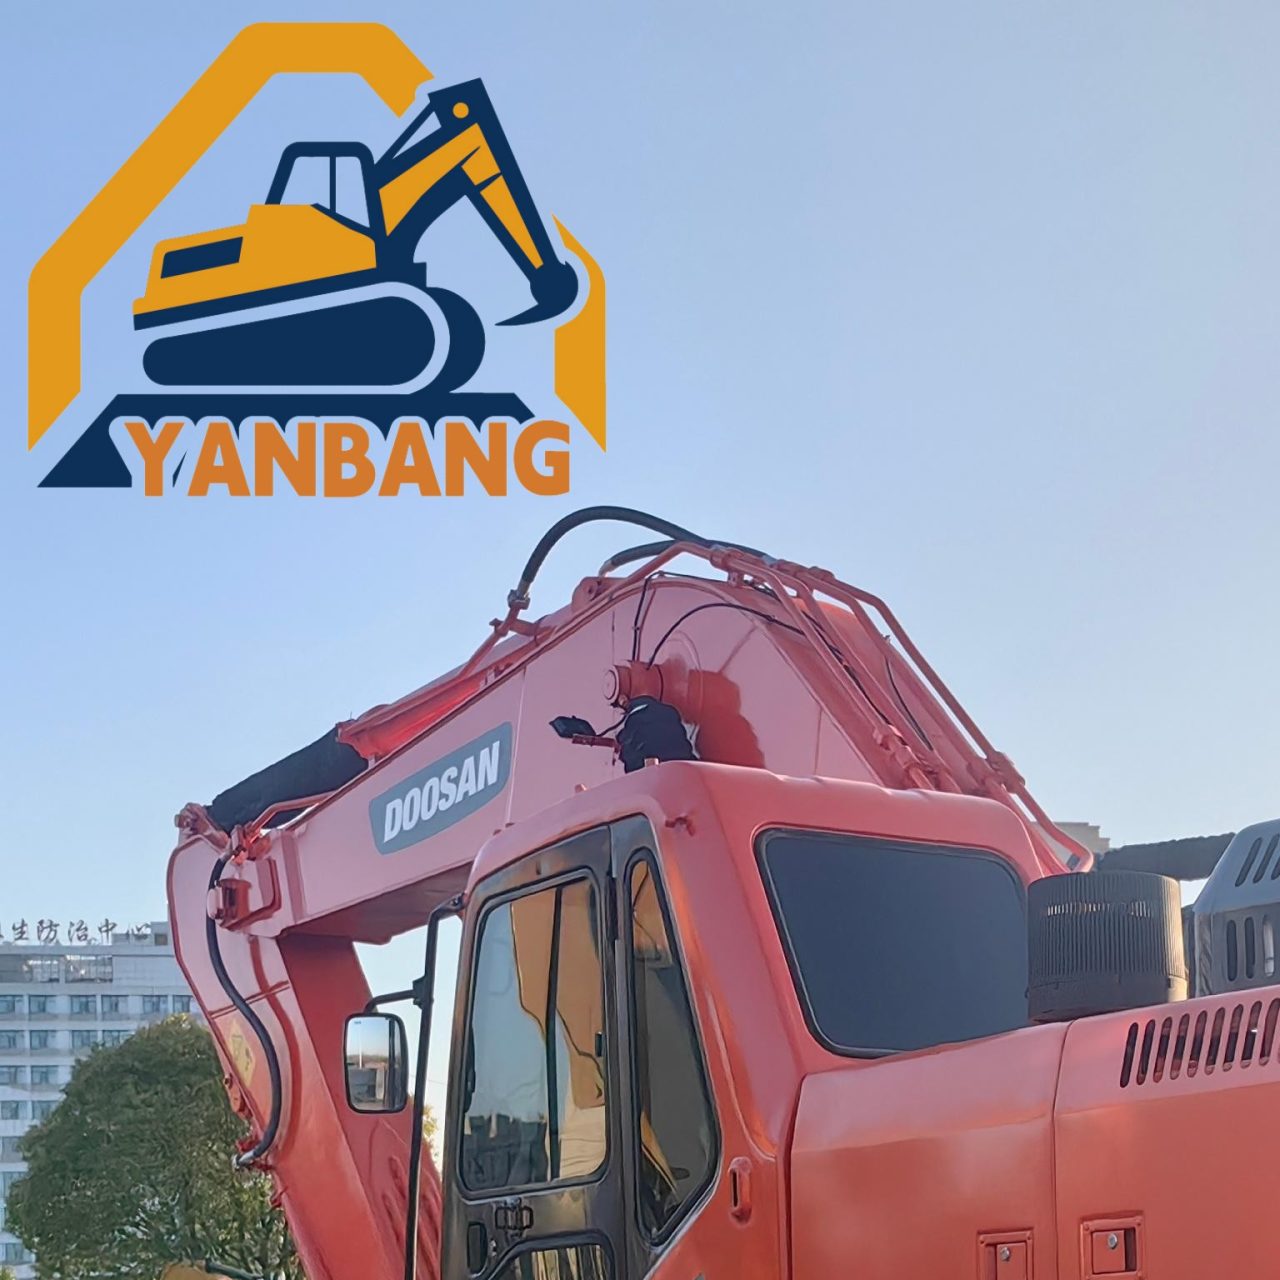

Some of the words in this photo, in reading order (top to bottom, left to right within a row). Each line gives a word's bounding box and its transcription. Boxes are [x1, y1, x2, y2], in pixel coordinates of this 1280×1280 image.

[383, 740, 500, 843] DOOSAN
[0, 918, 150, 943] 生防治中心
